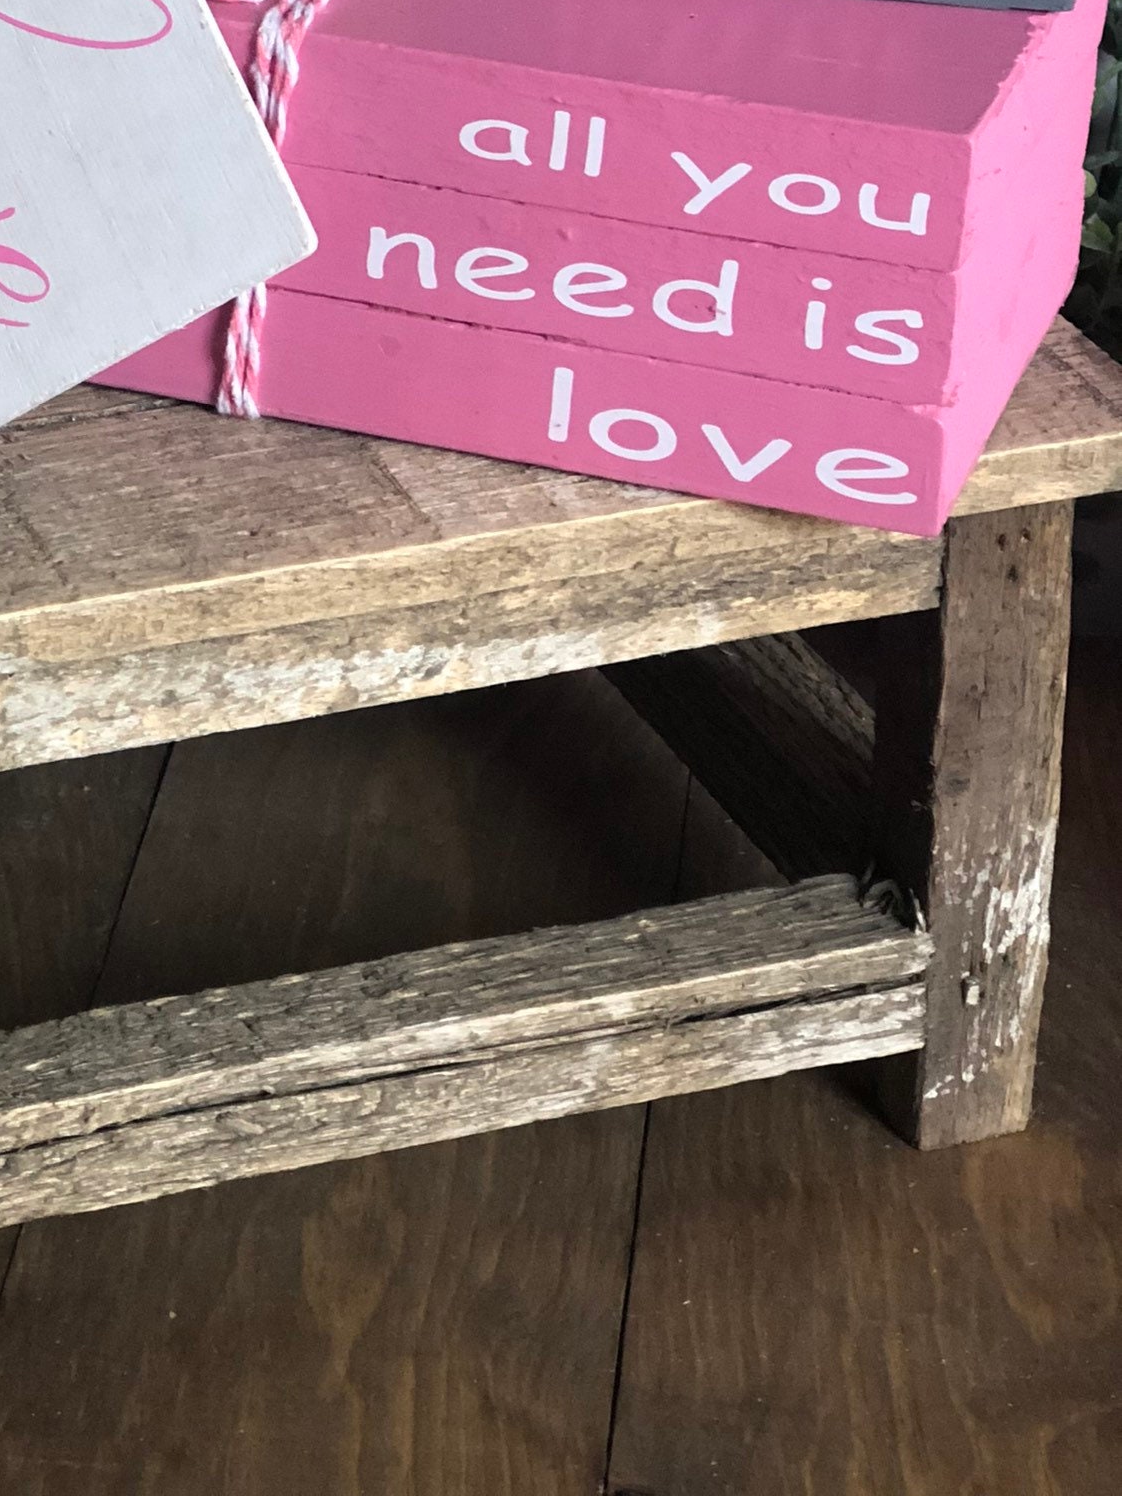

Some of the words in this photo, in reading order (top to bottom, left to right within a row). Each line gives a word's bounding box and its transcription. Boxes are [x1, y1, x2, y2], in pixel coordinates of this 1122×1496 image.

[459, 111, 606, 178] all
[671, 151, 931, 237] you
[366, 226, 739, 336] need
[804, 277, 925, 366] is
[548, 367, 918, 506] love
